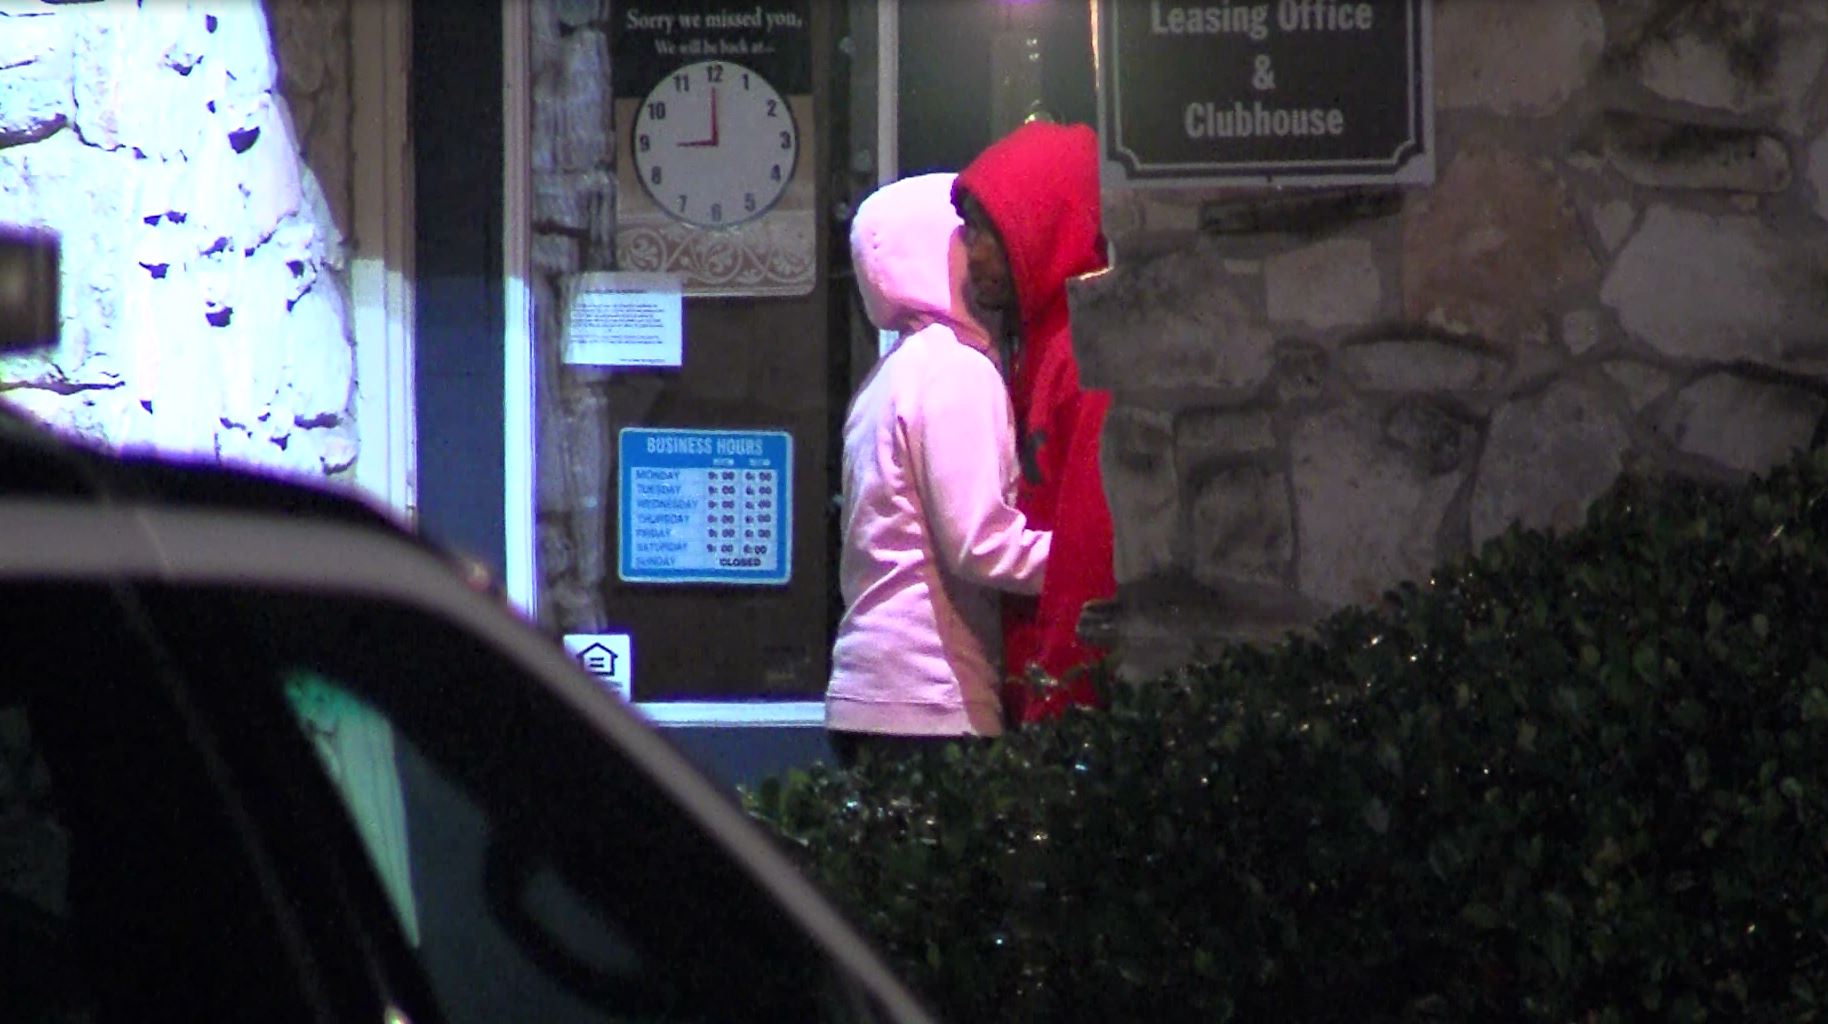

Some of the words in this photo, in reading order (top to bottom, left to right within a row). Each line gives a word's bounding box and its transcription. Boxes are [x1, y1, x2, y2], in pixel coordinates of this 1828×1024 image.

[627, 8, 674, 34] Sorry
[679, 14, 700, 28] we
[706, 6, 761, 28] missed
[1152, 0, 1269, 39] Leasing
[1277, 1, 1373, 30] Office
[655, 39, 674, 54] We
[720, 38, 748, 53] back
[707, 65, 723, 83] 12
[1253, 54, 1275, 90] &
[674, 75, 690, 92] 11
[742, 74, 750, 90] 1
[648, 102, 665, 120] 10
[767, 100, 777, 117] 2
[1185, 102, 1344, 138] Clubhouse
[639, 134, 650, 152] 9
[780, 131, 791, 149] 3
[651, 166, 662, 185] 8
[771, 164, 781, 181] 4
[679, 195, 688, 212] 7
[744, 193, 756, 211] 5
[710, 203, 722, 222] 6
[647, 437, 713, 454] BUSINESS
[717, 438, 763, 456] HOURS
[635, 469, 681, 480] MONDAY
[719, 557, 761, 567] CLOSED
